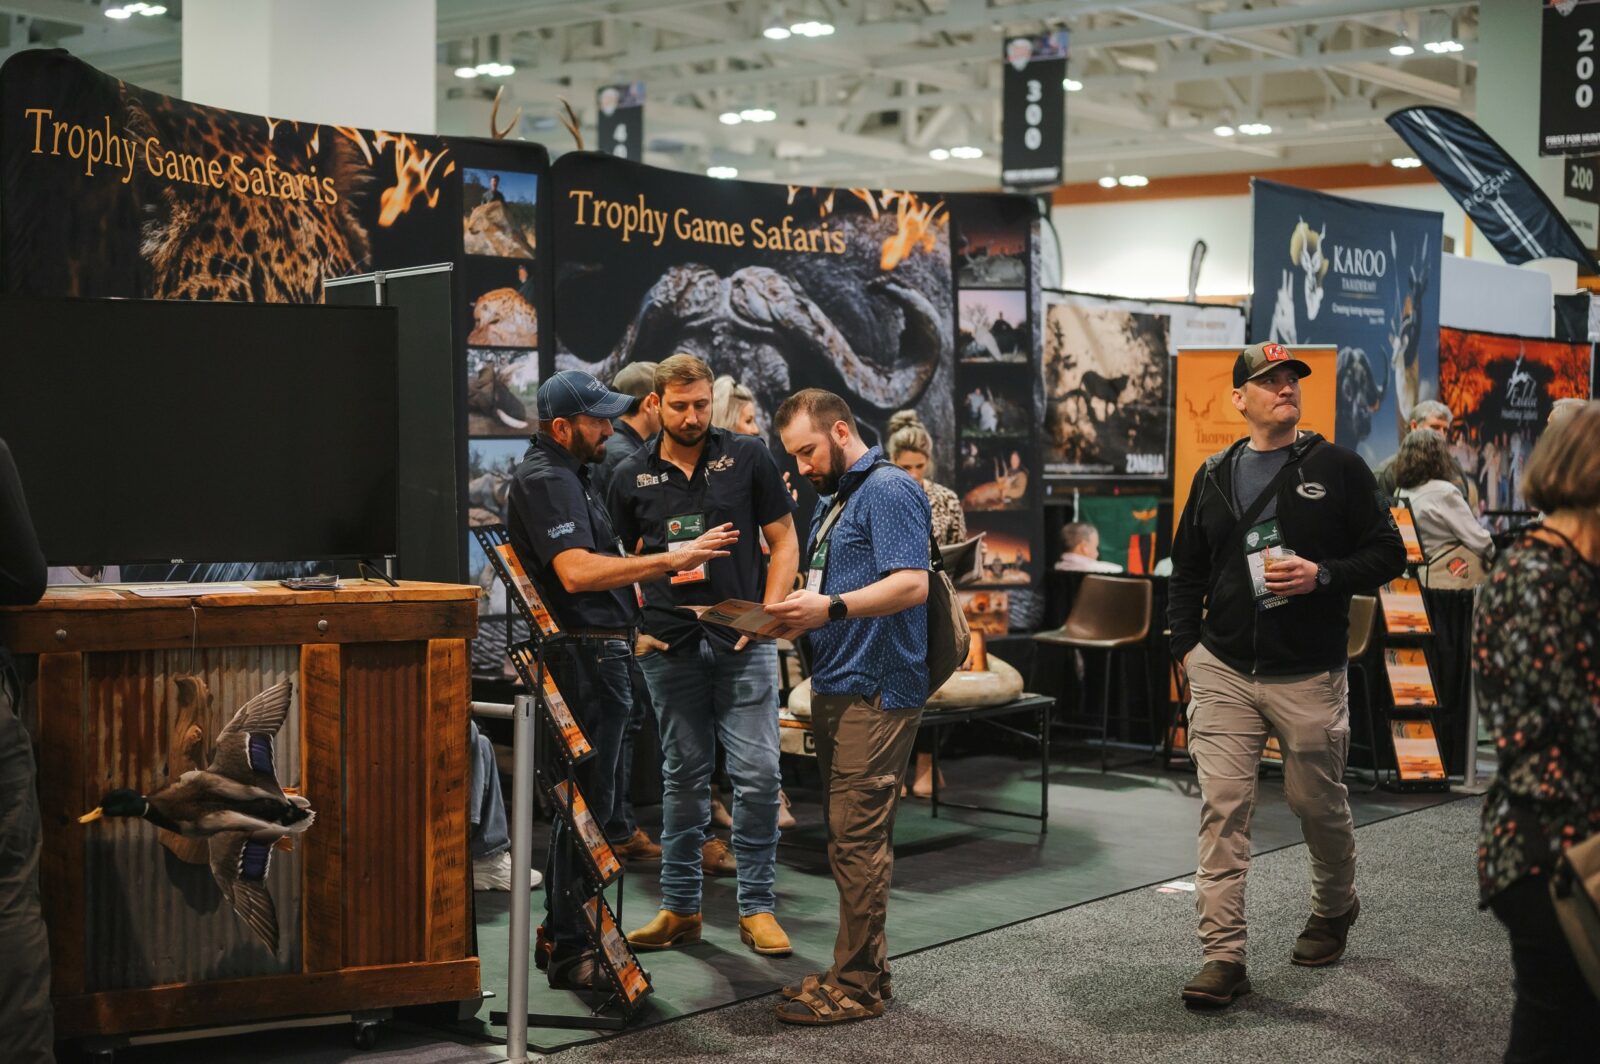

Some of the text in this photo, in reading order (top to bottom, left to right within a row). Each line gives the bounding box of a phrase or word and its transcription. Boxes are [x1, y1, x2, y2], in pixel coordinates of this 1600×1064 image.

[1575, 28, 1594, 108] 200
[1024, 79, 1043, 150] 300
[25, 108, 338, 205] Trophy Game Safaris
[1571, 165, 1593, 191] 200
[569, 190, 846, 254] Trophy Game Safaris
[1333, 245, 1386, 278] KAROO
